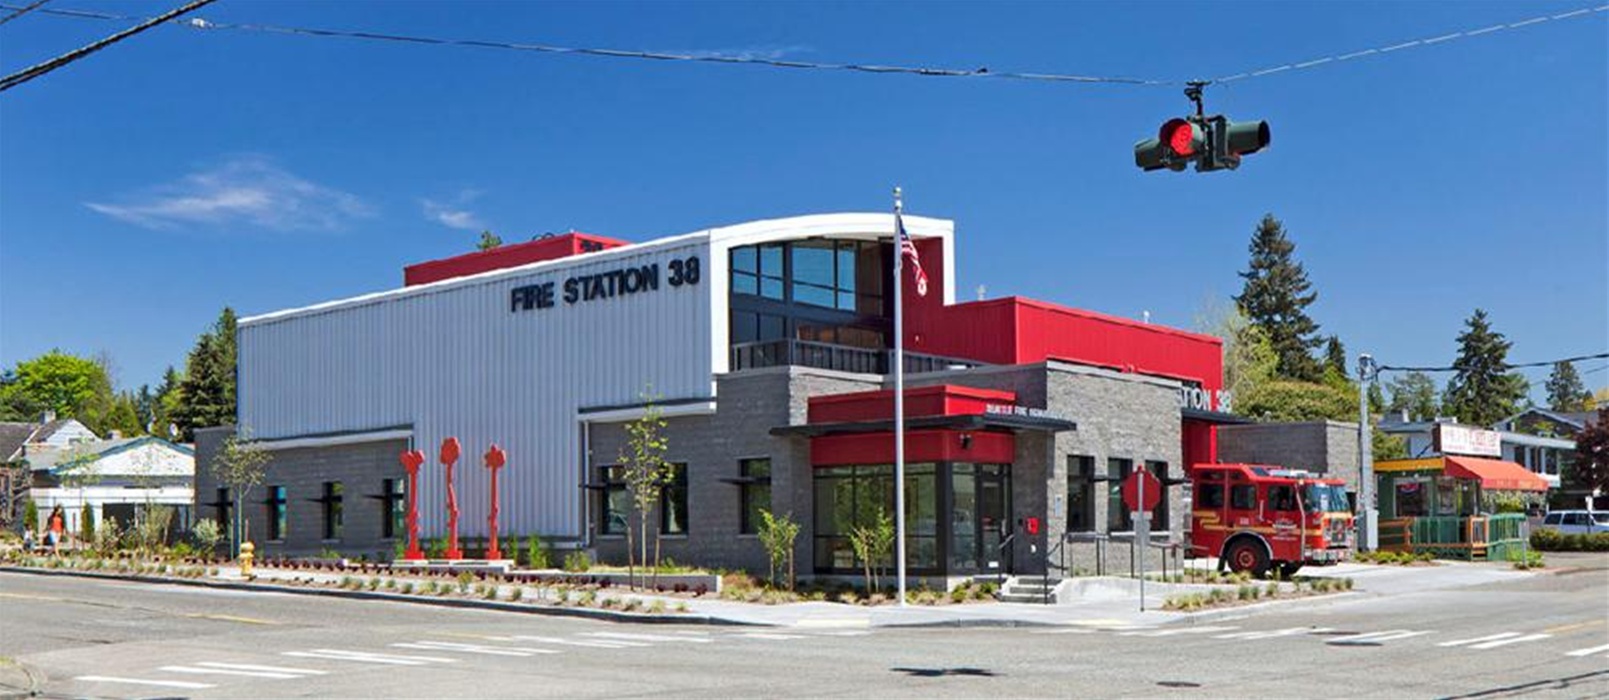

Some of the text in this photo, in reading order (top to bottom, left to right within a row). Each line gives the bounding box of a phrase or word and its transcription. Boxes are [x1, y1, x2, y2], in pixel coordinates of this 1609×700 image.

[511, 256, 701, 313] FIRE STATION 38
[1215, 389, 1232, 413] 38
